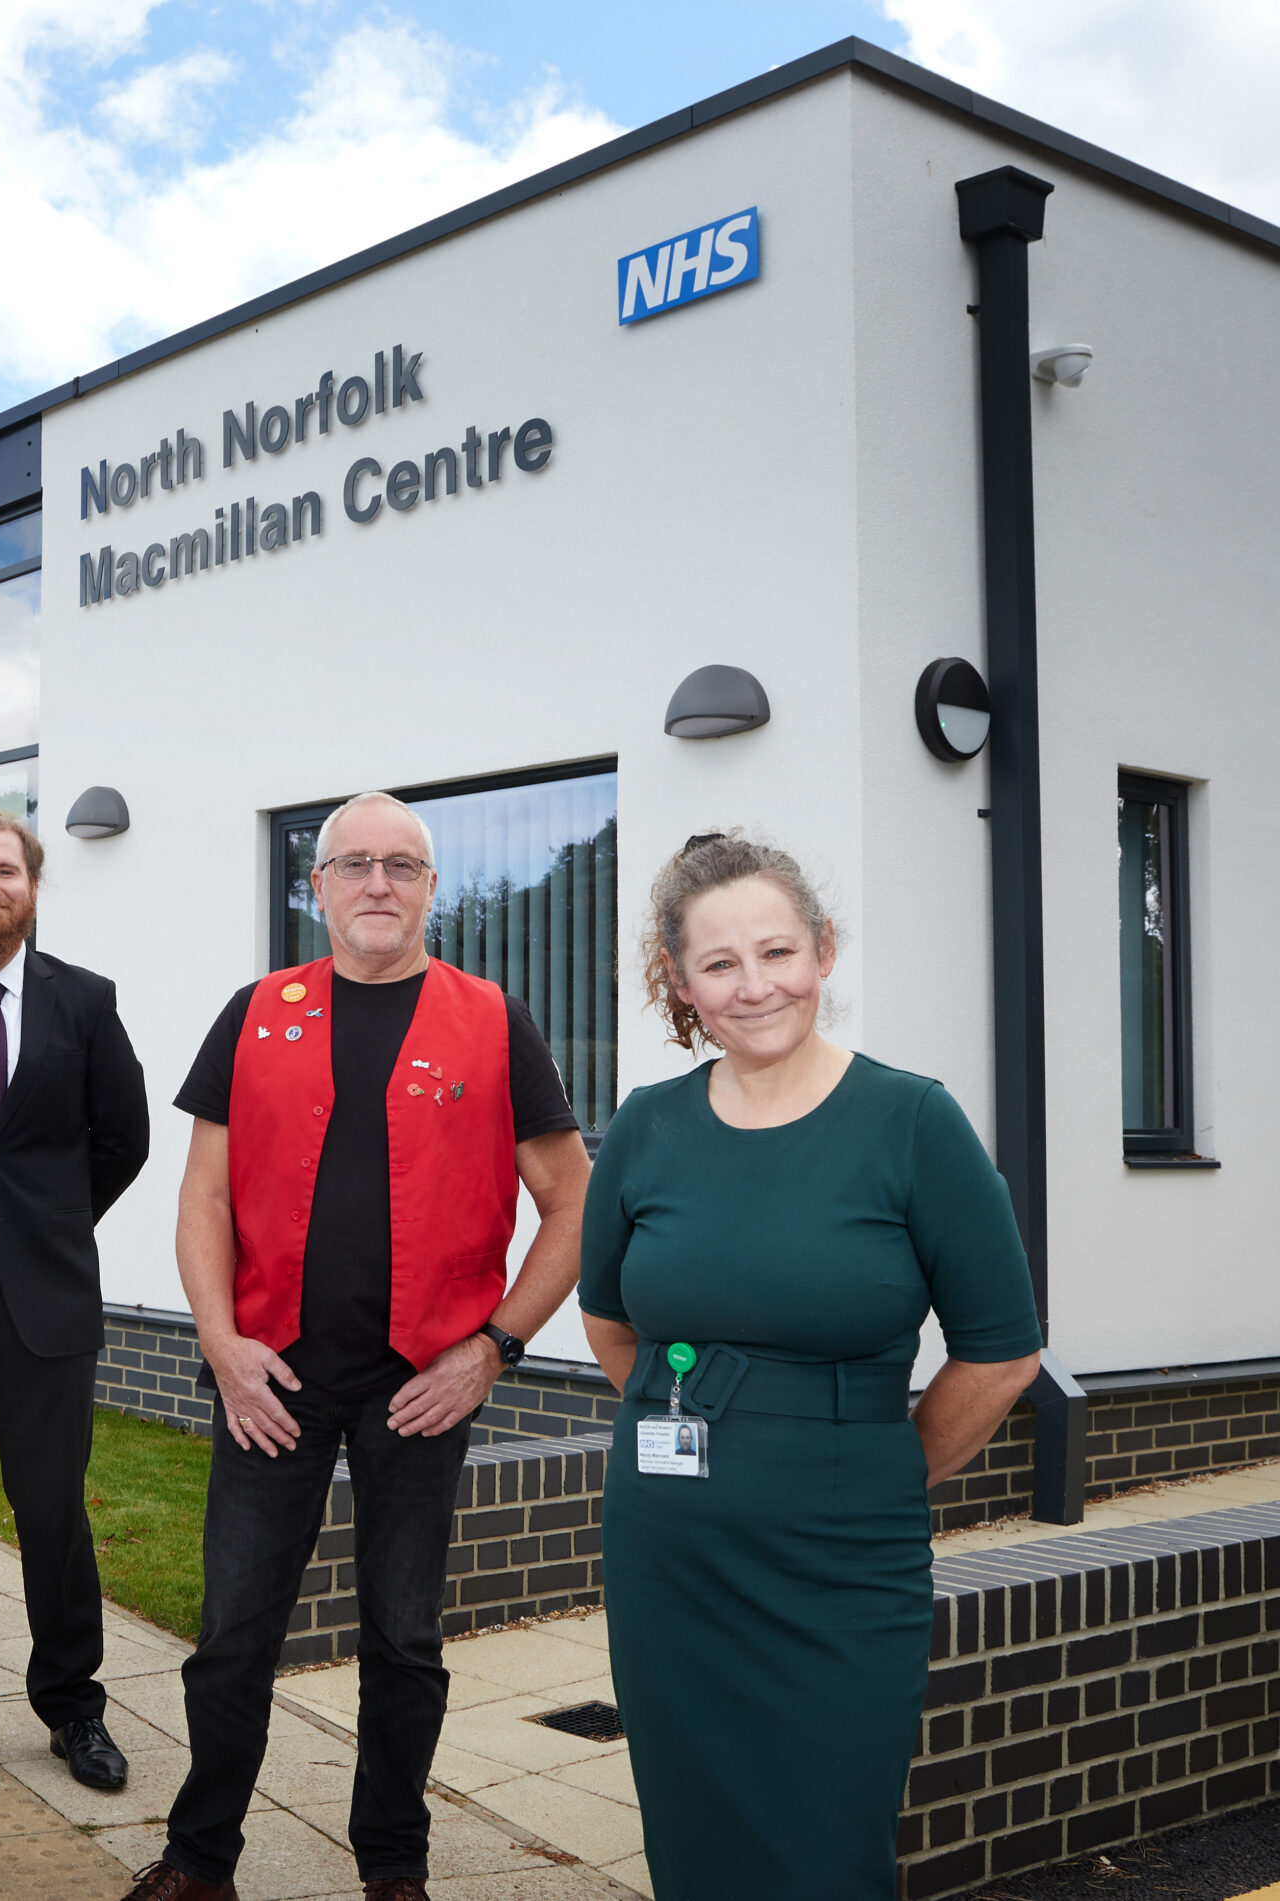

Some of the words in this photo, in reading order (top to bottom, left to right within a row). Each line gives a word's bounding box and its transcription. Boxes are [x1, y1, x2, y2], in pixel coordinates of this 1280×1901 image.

[622, 215, 751, 318] NHS
[80, 491, 321, 607] Macmillan
[343, 418, 552, 523] Centre
[81, 428, 201, 520] North
[223, 344, 424, 469] Norfolk
